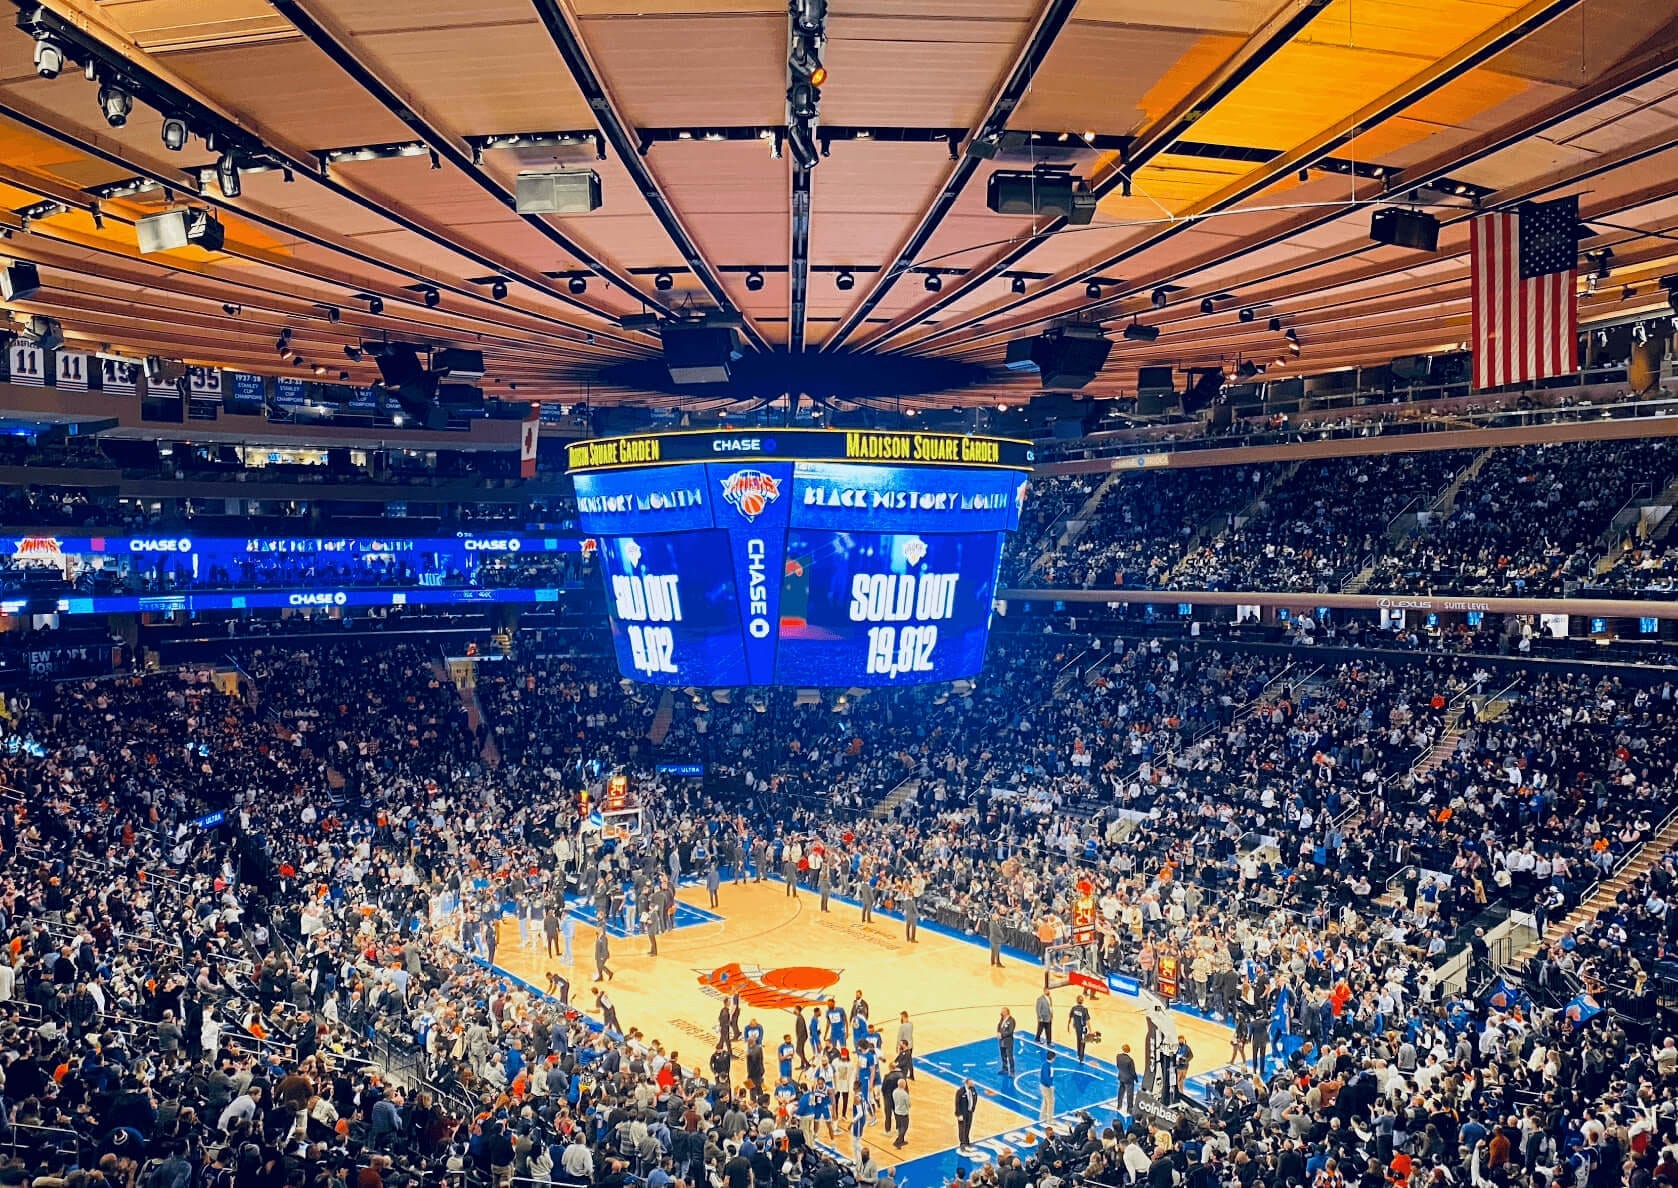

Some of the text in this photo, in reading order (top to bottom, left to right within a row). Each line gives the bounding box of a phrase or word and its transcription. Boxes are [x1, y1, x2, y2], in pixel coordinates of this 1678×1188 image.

[17, 349, 37, 374] 11
[62, 355, 81, 380] 11
[620, 438, 660, 463] GARDEN
[713, 438, 761, 452] CHASE
[846, 431, 1000, 464] MADISON SQUARE GARDEN
[803, 485, 867, 508] BLACK
[873, 488, 959, 510] HISTORY
[130, 539, 178, 551] CHASE
[464, 539, 508, 551] CHASE
[747, 538, 768, 616] CHASE
[289, 593, 334, 605] CHASE
[849, 572, 960, 622] SOLD OUT
[1391, 601, 1489, 611] LEXUS SUITE LEVEL
[866, 624, 938, 680] 19,812
[1138, 1100, 1178, 1123] coinbas
